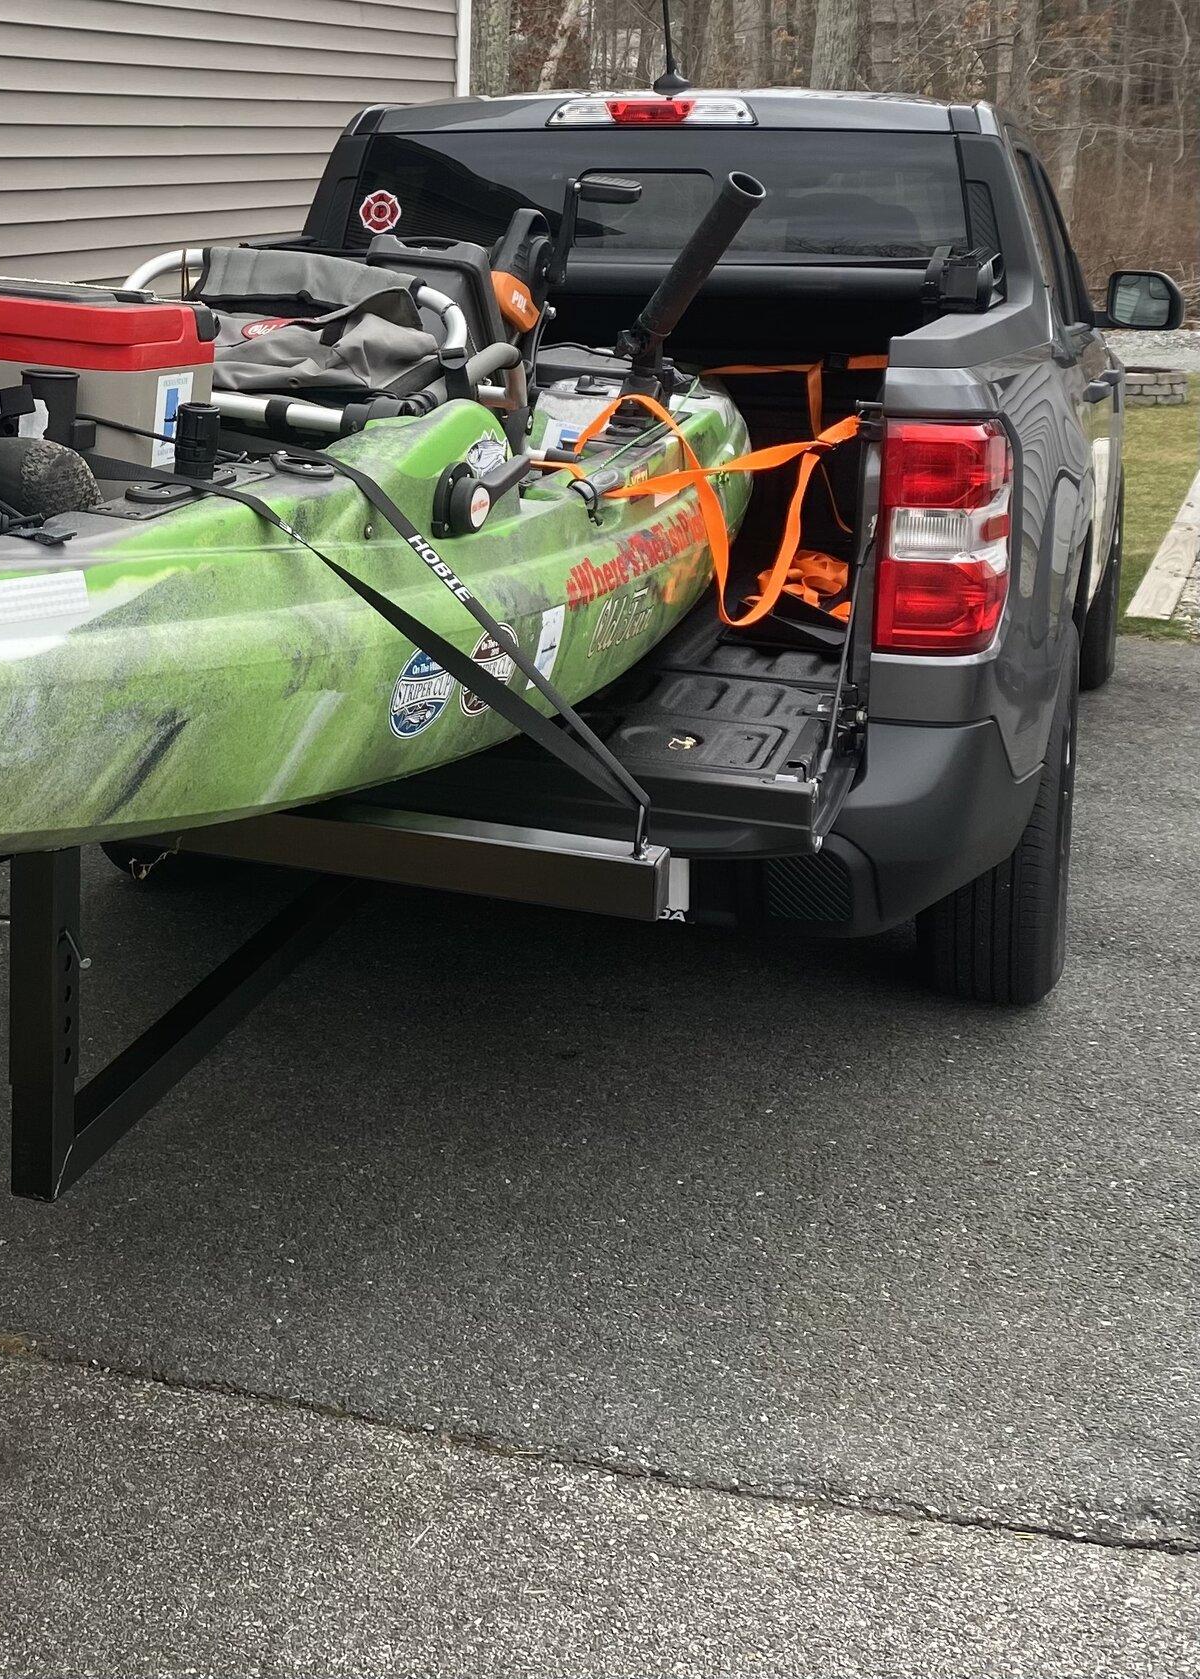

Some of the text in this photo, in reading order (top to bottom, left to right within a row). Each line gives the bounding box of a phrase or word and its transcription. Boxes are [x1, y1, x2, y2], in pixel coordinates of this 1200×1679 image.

[511, 289, 527, 314] PDL
[408, 534, 473, 602] HOBIE
[393, 680, 432, 709] STRIPER
